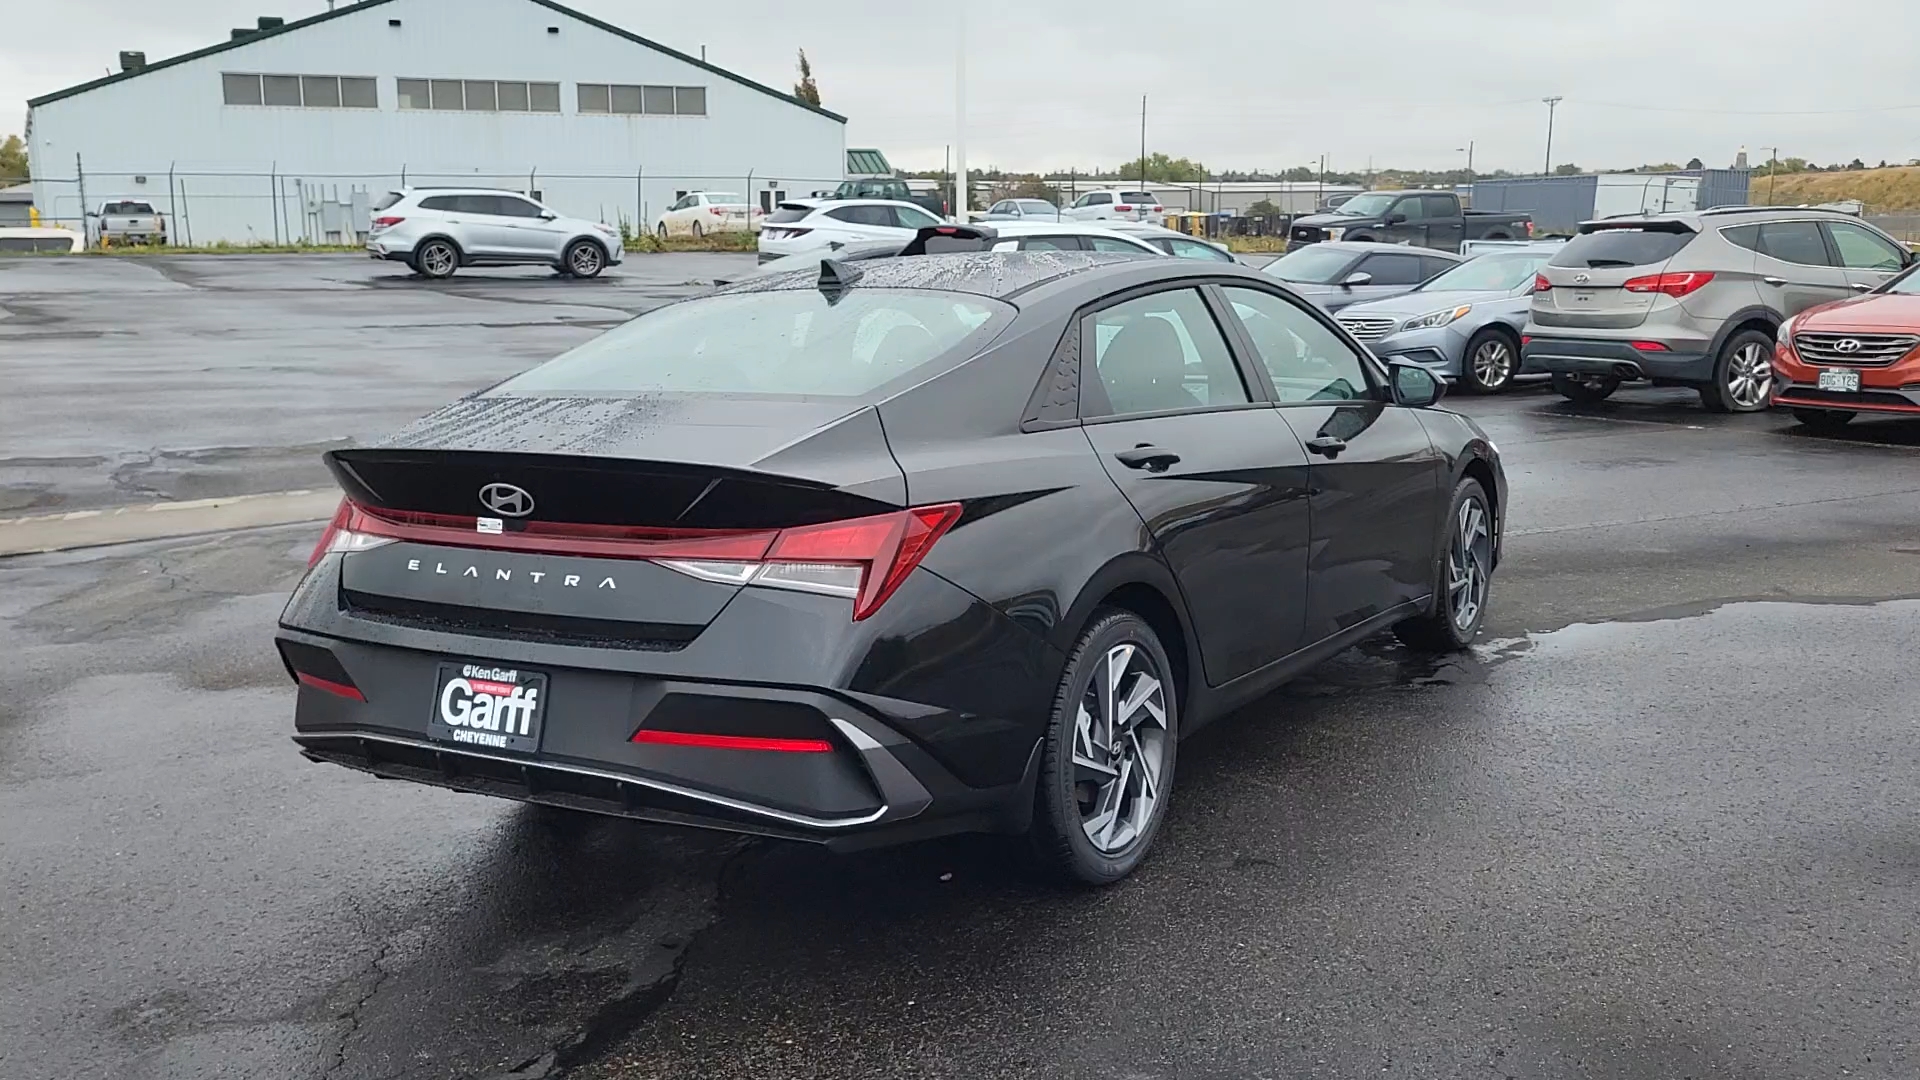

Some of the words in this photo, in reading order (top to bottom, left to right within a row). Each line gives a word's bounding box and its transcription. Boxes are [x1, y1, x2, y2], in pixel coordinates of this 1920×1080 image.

[407, 559, 616, 589] ELANTRA
[471, 665, 490, 680] Ken
[491, 667, 517, 683] Garff
[441, 678, 537, 735] Garff
[453, 729, 508, 748] CHEYENNE
